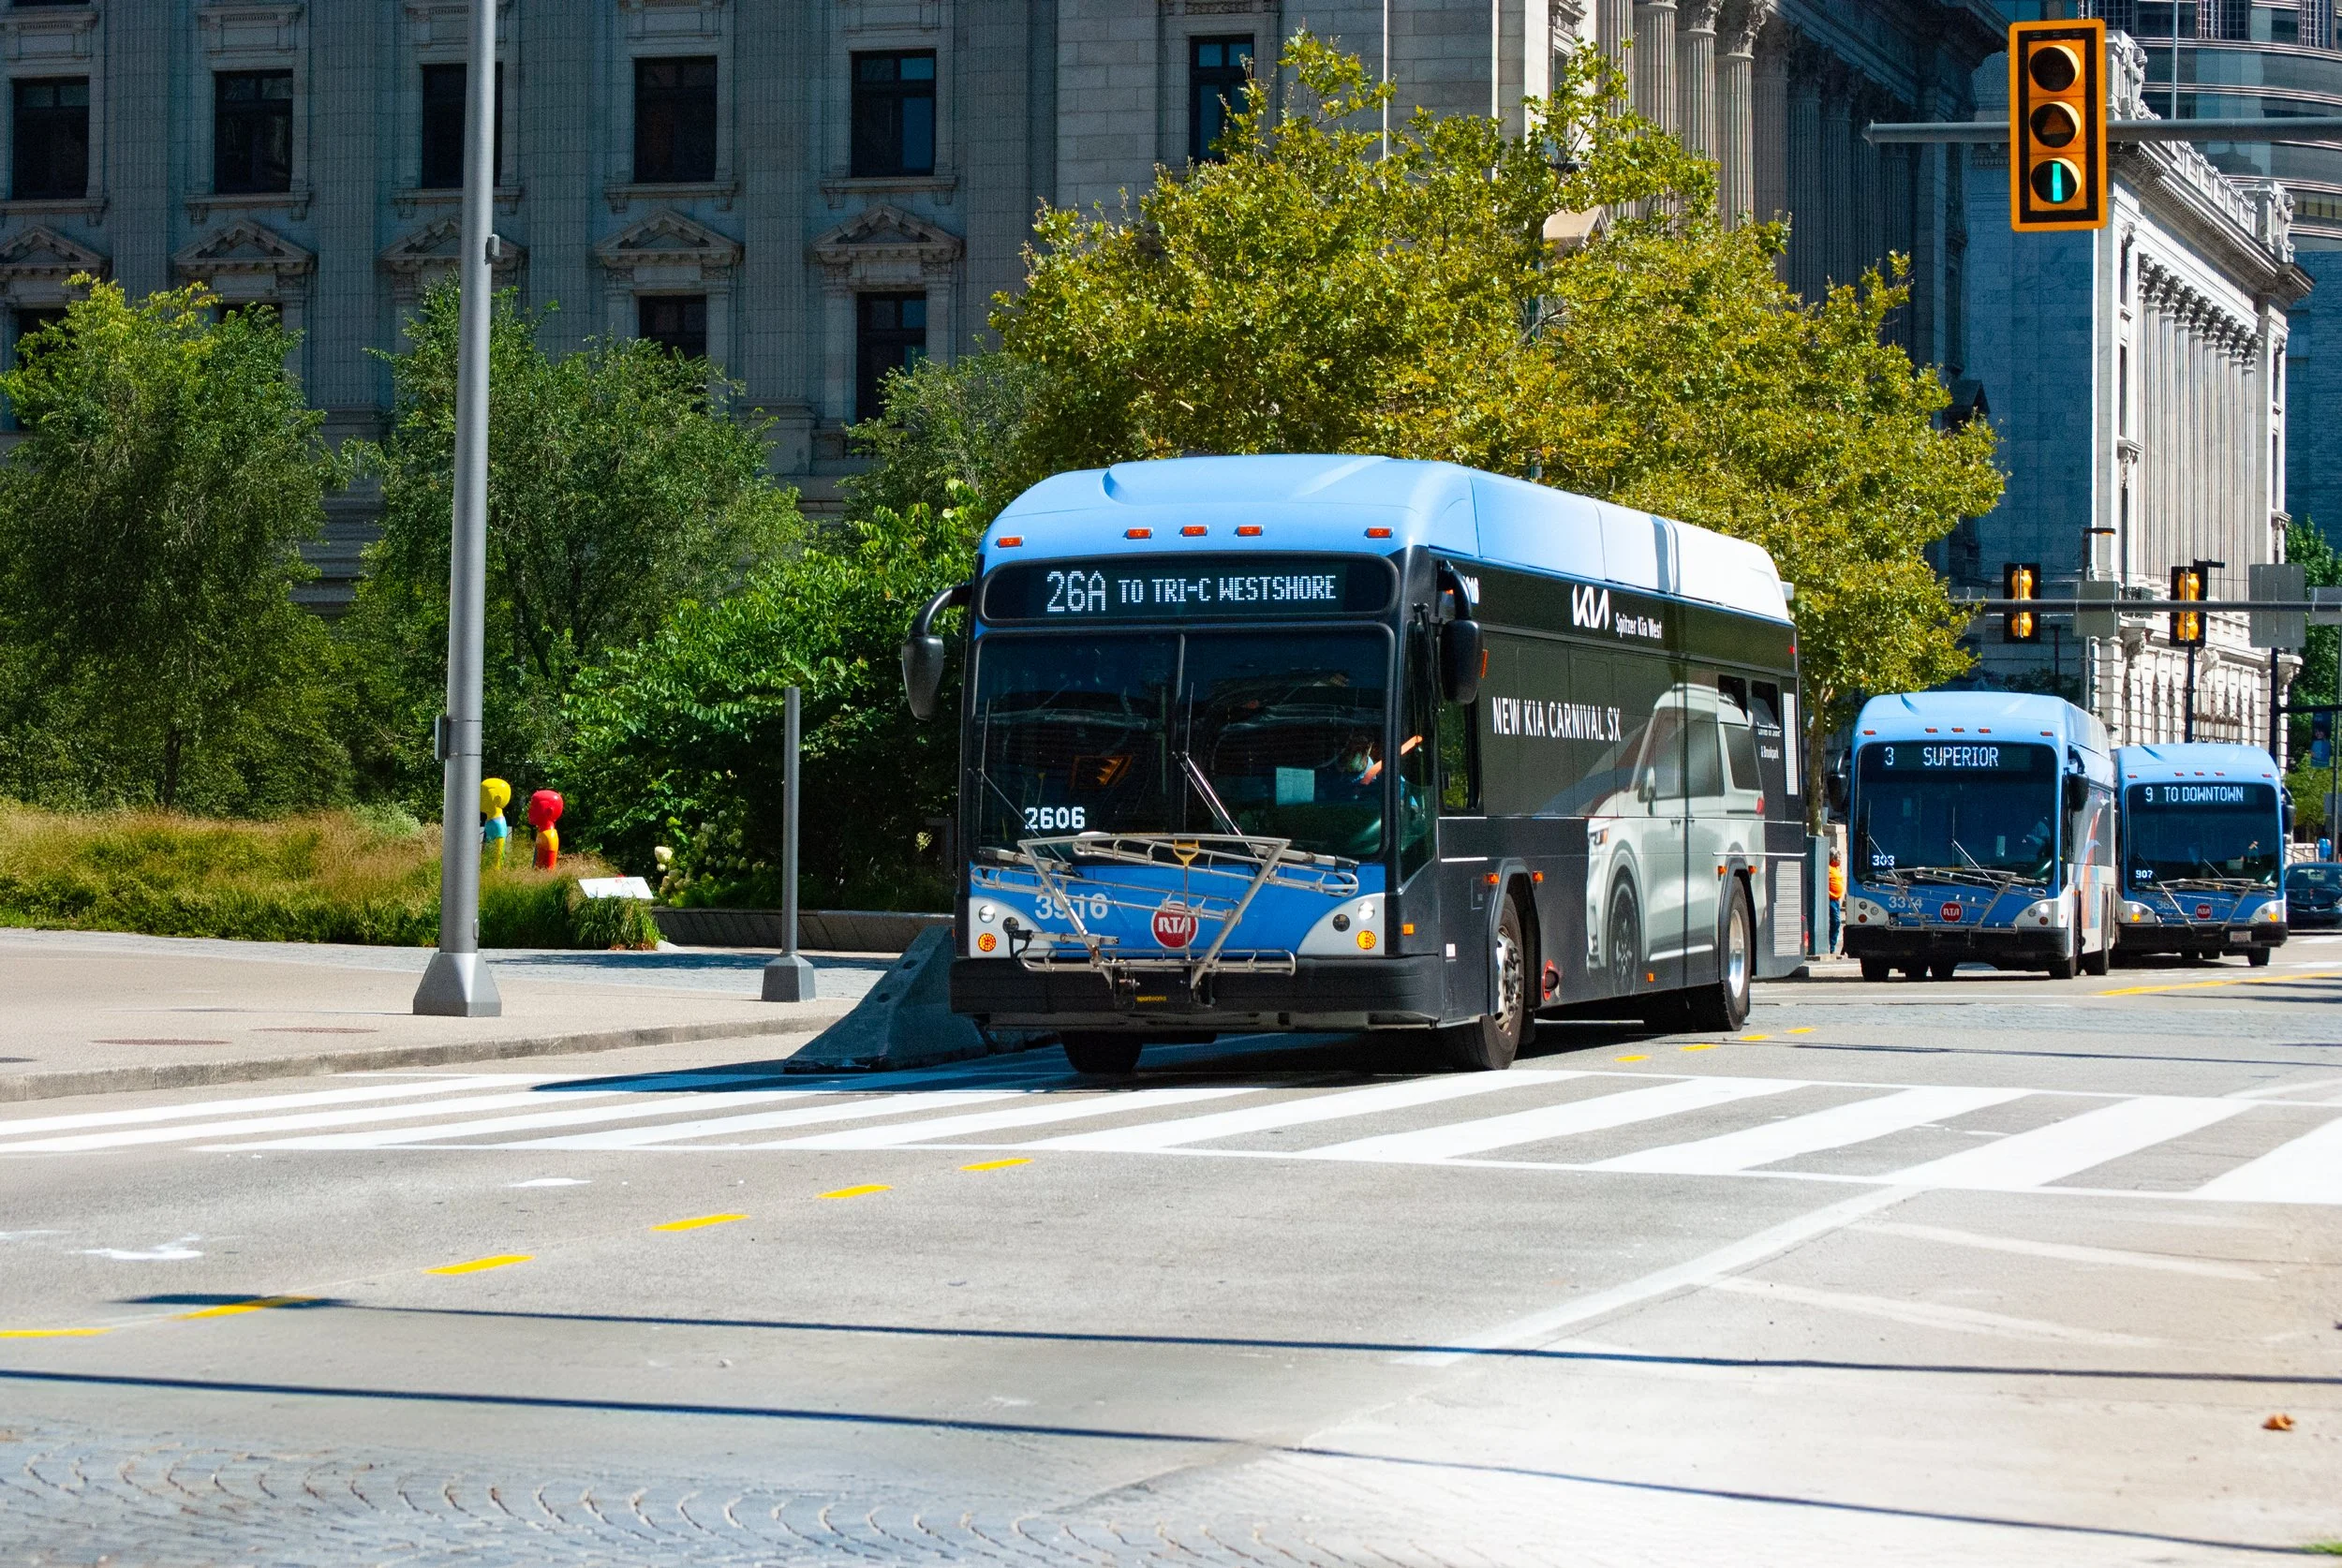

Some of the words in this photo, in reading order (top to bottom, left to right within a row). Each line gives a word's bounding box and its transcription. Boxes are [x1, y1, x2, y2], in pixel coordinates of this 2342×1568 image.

[1046, 570, 1106, 612] 26A
[1118, 579, 1144, 603] TO
[1151, 578, 1211, 602] TRI-C
[1219, 575, 1337, 601] WESTSHORE
[1462, 575, 1479, 604] 916
[1615, 612, 1637, 638] Spitzer
[1637, 615, 1648, 637] Kia
[1648, 618, 1663, 639] West
[1492, 697, 1520, 735] NEW
[1524, 700, 1546, 737] KIA
[1549, 701, 1605, 740] CARNIVAL
[1607, 706, 1622, 742] SX
[1884, 747, 1894, 766] 3
[1922, 747, 1999, 766] SUPERIOR
[2145, 787, 2154, 803] 9
[2163, 787, 2179, 803] TO
[2182, 786, 2244, 802] DOWNTOWN
[1024, 806, 1086, 830] 2606
[1872, 855, 1895, 866] 303
[2136, 869, 2153, 879] 907
[1034, 893, 1108, 920] 3916
[1943, 907, 1960, 917] RTA
[1158, 916, 1192, 934] RTA
